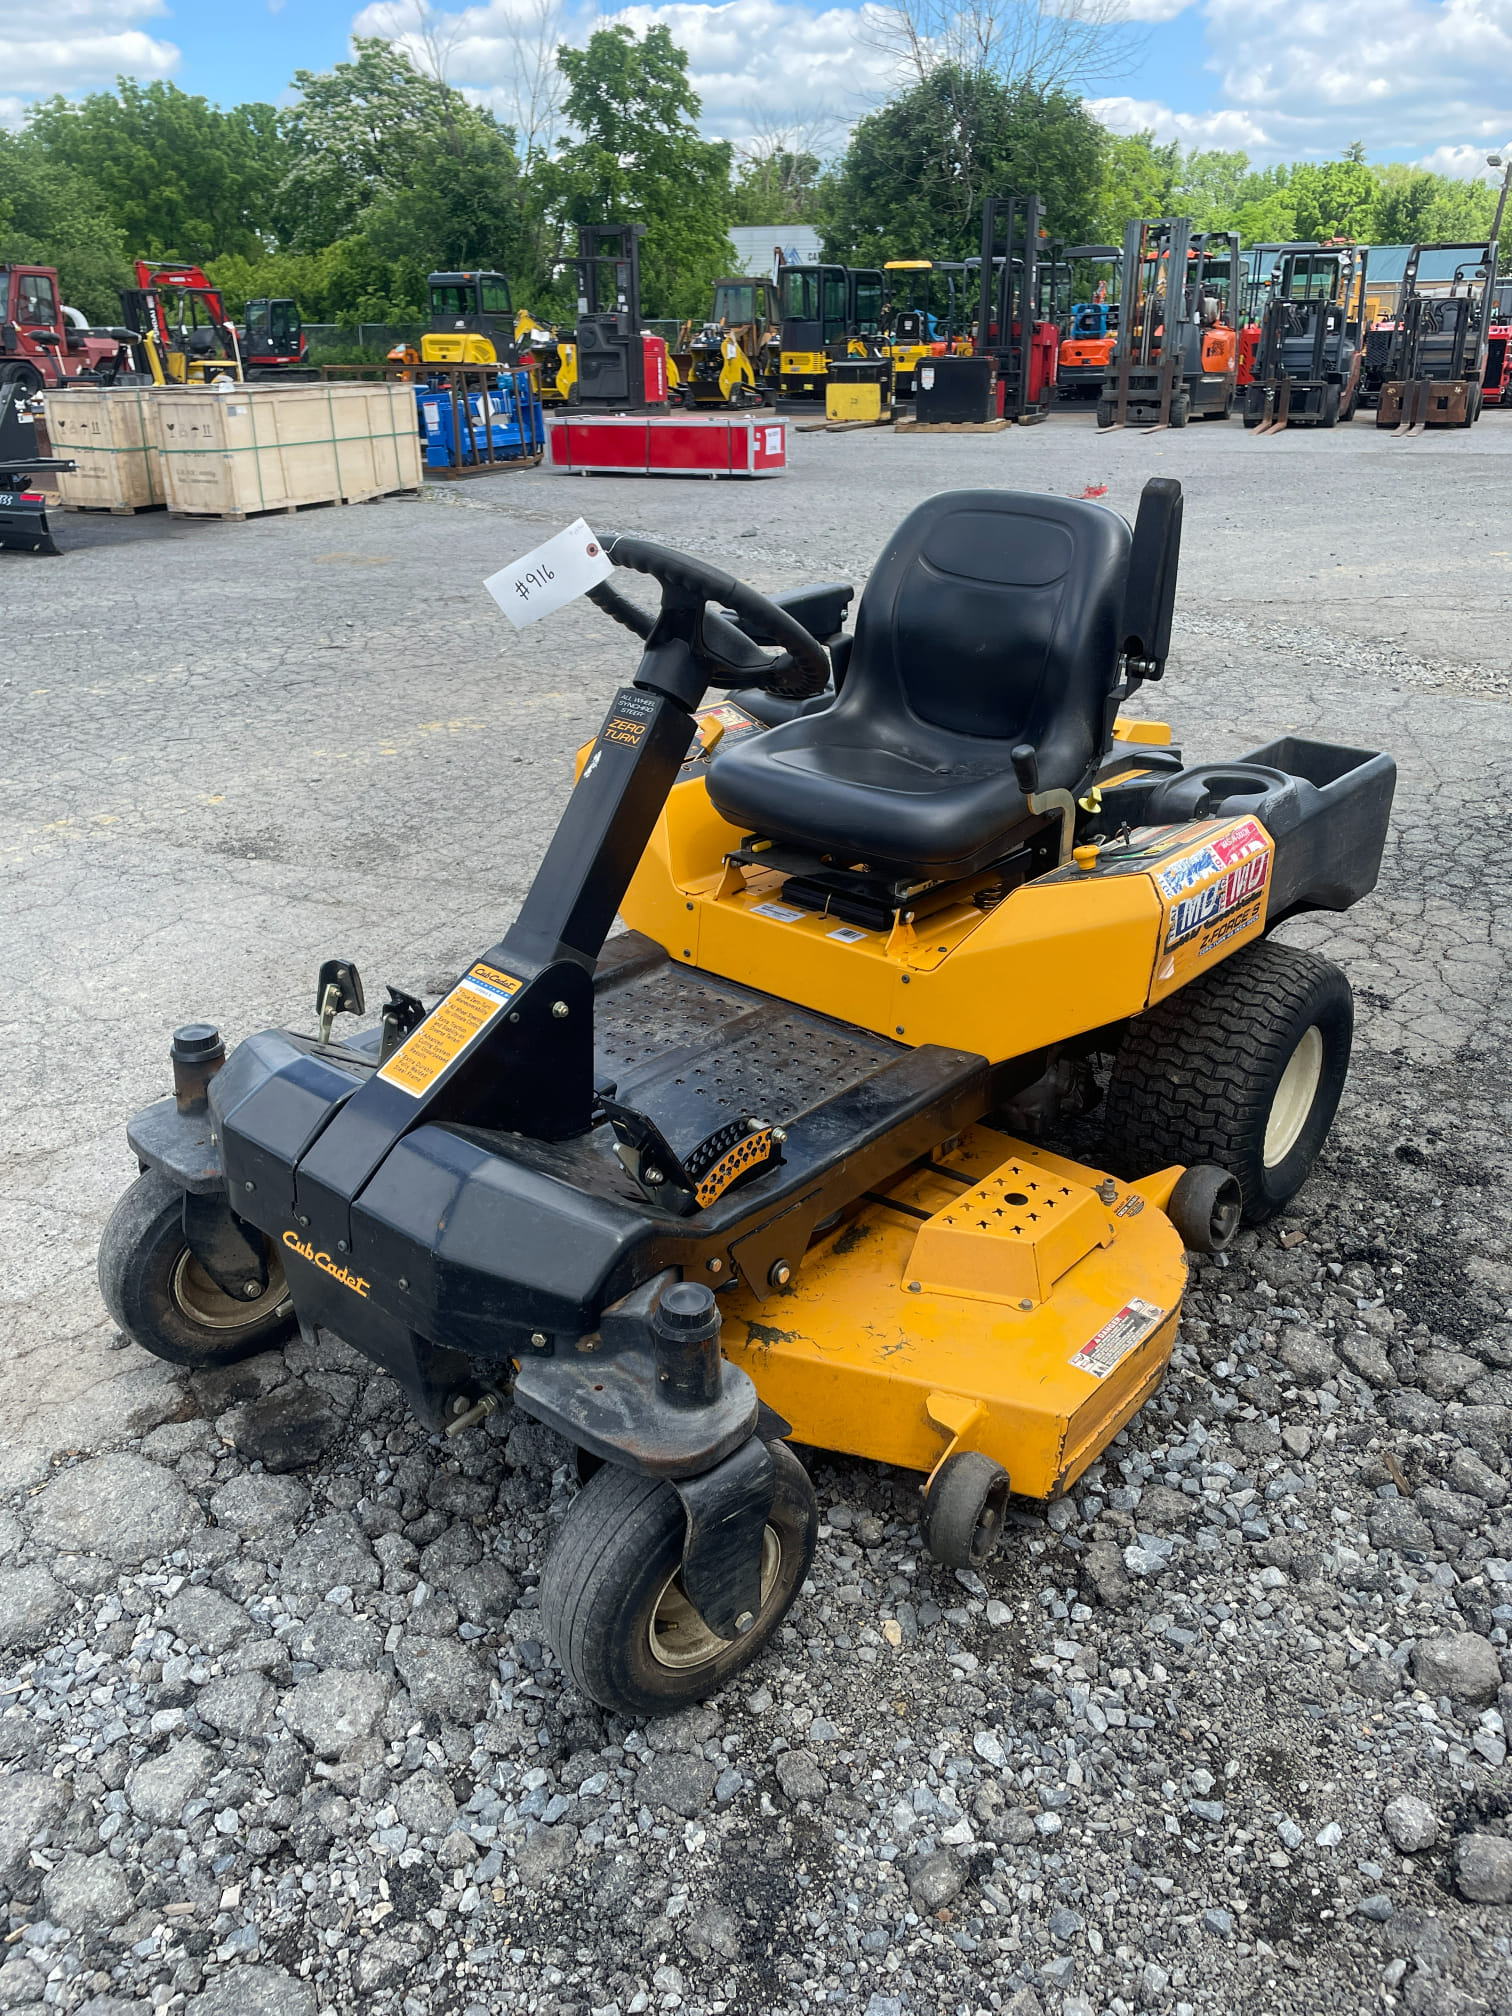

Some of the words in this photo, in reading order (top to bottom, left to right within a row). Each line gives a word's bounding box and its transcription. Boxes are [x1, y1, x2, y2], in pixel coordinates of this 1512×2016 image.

[515, 564, 555, 600] #916
[618, 700, 654, 713] SYNCHRO
[634, 697, 656, 707] WHEEL
[620, 707, 645, 717] STEER
[605, 728, 640, 744] TURN
[608, 718, 646, 735] ZERO
[1200, 909, 1250, 949] Z-FORCE
[475, 968, 490, 978] Cub
[489, 975, 517, 990] Cadet
[282, 1230, 314, 1260] Cub
[314, 1252, 371, 1298] Cadet
[1098, 1316, 1122, 1339] DANGER
